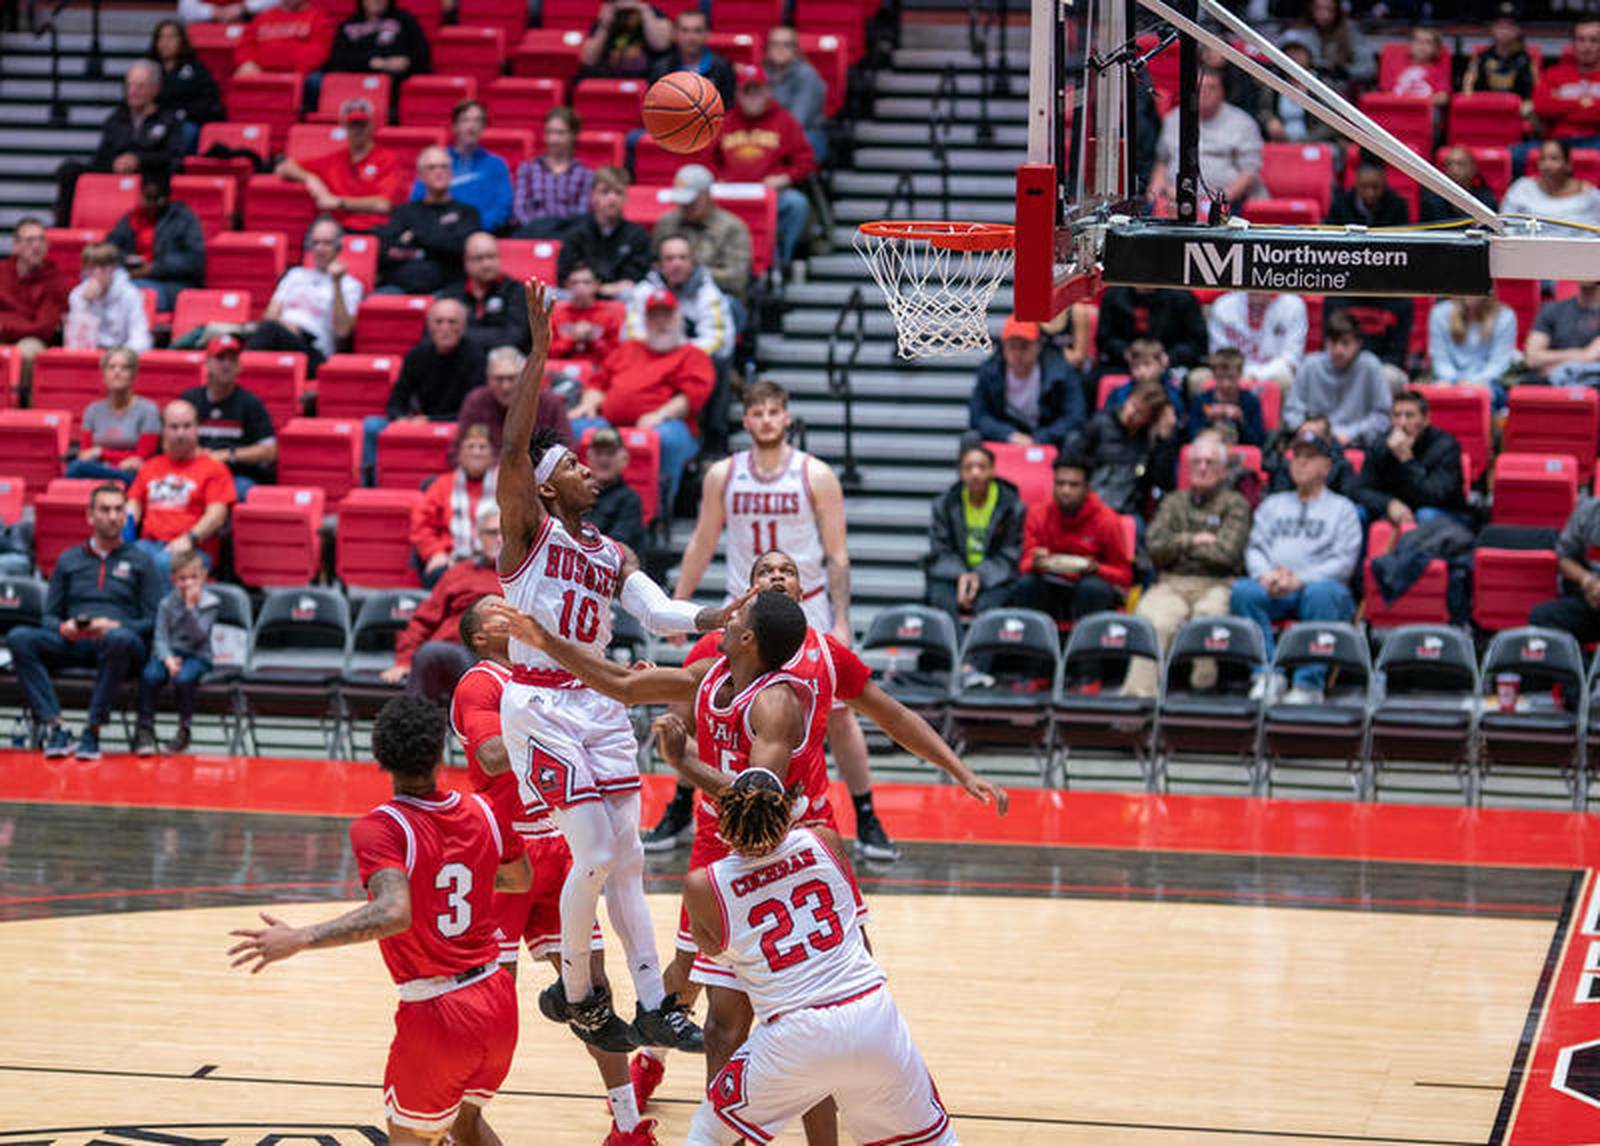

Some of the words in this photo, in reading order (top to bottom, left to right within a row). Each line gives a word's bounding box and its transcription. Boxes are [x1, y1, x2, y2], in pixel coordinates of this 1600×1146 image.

[1252, 243, 1408, 266] Northwestern
[732, 492, 800, 515] HUSKIES
[751, 520, 778, 556] 11
[544, 543, 618, 599] HUSKIE
[558, 588, 601, 644] 10
[730, 847, 818, 898] COCHRAN
[435, 862, 474, 939] 3
[747, 878, 844, 973] 23
